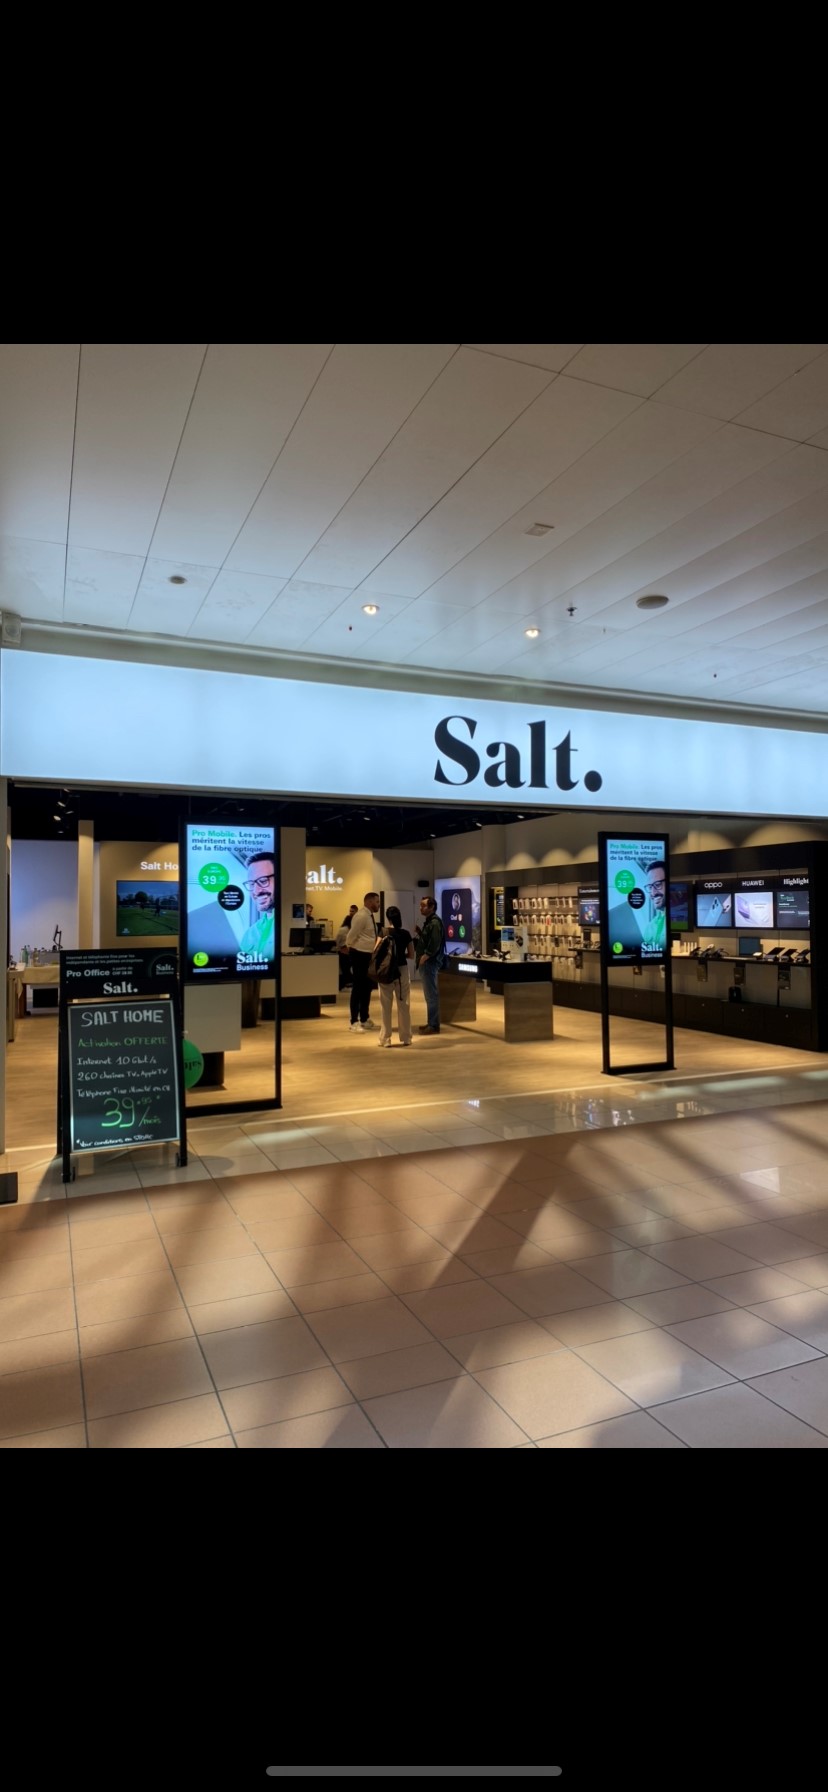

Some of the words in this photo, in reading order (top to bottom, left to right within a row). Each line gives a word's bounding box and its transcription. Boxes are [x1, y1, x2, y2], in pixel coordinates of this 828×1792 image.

[434, 715, 603, 793] Salt.
[140, 861, 161, 870] Salt
[306, 864, 344, 885] alt.
[202, 875, 217, 885] 39
[641, 941, 663, 952] Salt.
[236, 951, 269, 964] Salt.
[66, 970, 82, 978] Pro
[84, 969, 111, 977] Office
[103, 981, 139, 995] Salt.
[81, 1011, 119, 1027] SALT
[123, 1009, 164, 1023] HOME
[124, 1036, 168, 1046] OFFERTE
[77, 1057, 112, 1066] Internet
[115, 1056, 131, 1065] 10
[77, 1071, 98, 1081] 260
